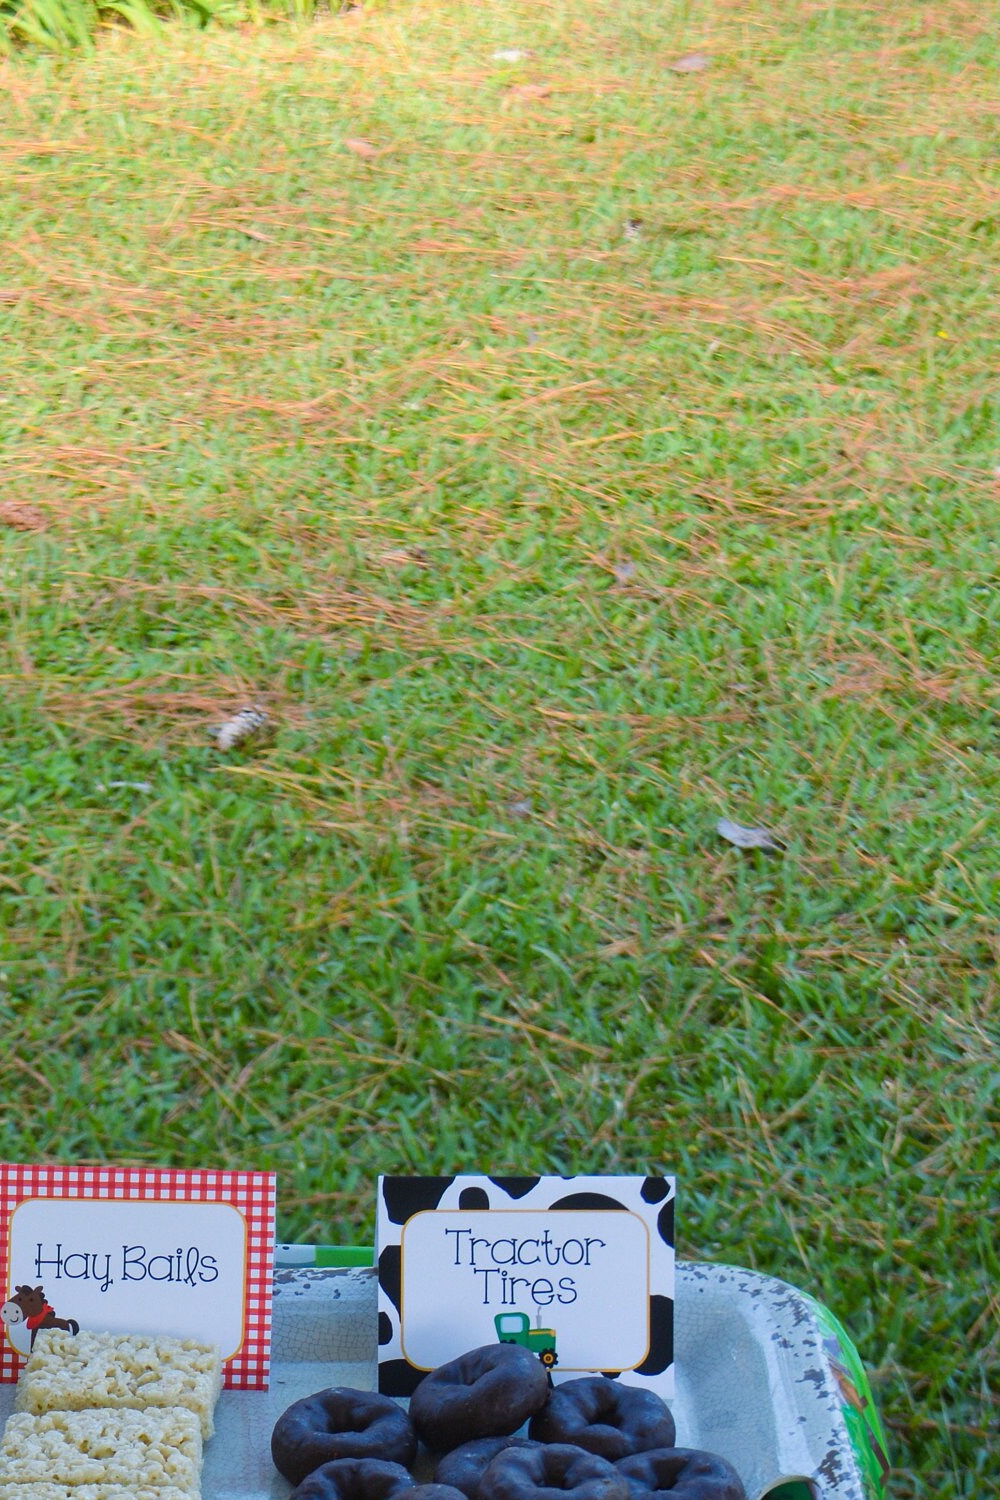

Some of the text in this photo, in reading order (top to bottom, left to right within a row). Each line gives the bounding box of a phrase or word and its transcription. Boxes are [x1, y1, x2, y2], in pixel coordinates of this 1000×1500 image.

[445, 1227, 606, 1266] Tractor
[34, 1243, 219, 1293] Hay Bails
[473, 1267, 578, 1306] Tires
